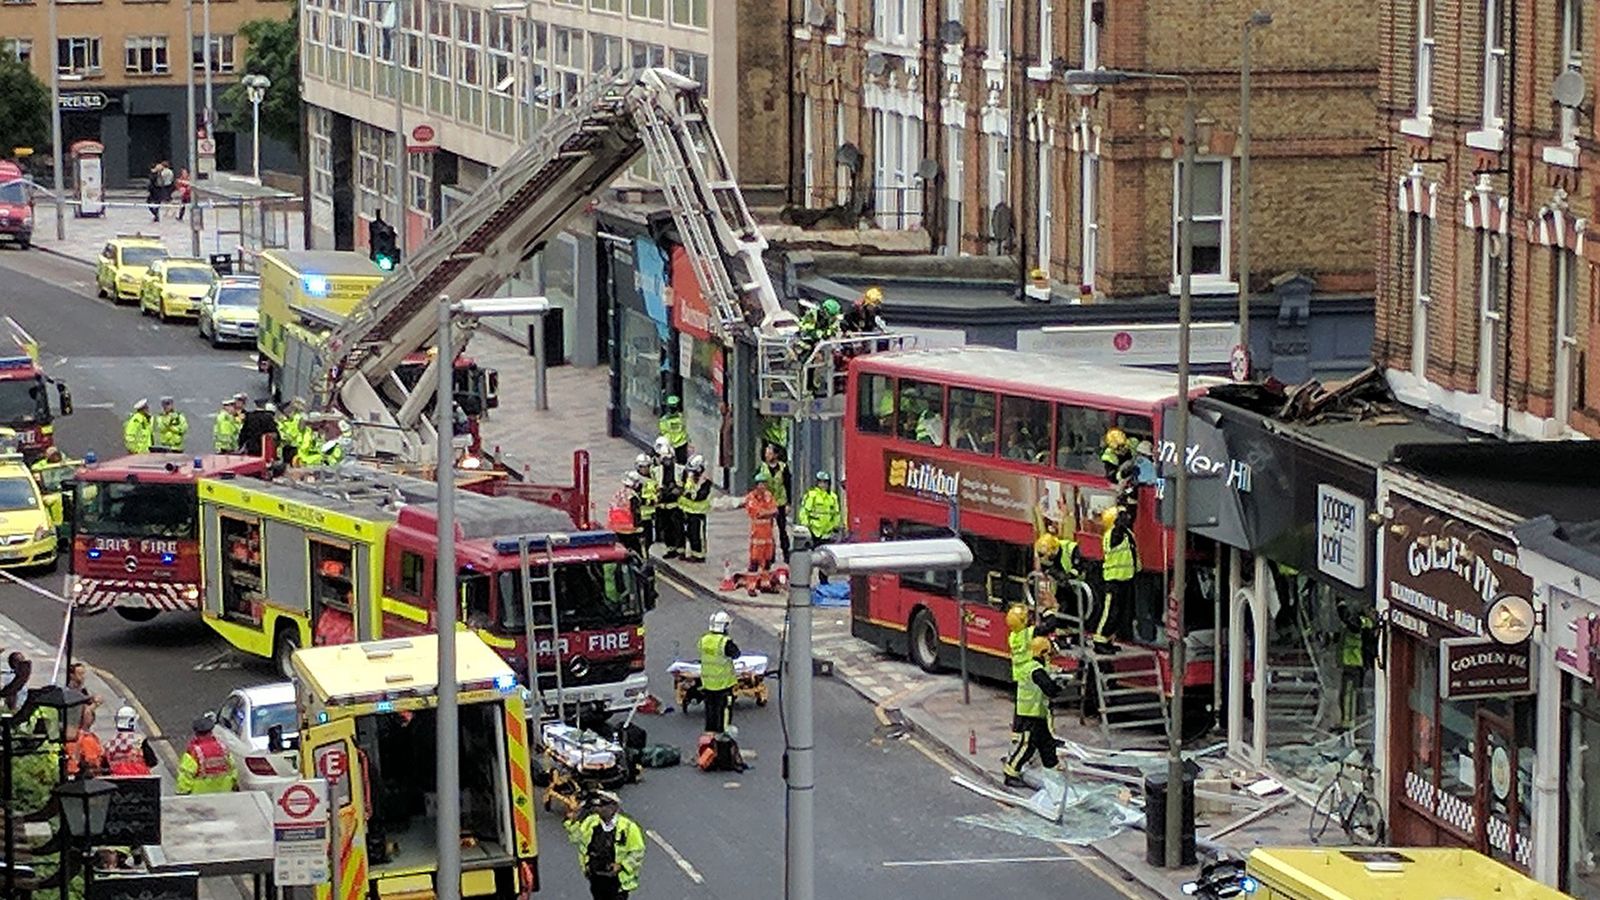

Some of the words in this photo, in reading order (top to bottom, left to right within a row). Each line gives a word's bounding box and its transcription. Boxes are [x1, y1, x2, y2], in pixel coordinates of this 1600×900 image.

[141, 541, 178, 554] FIRE
[588, 632, 630, 652] FIRE
[1451, 653, 1505, 672] GOLDEN
[326, 751, 342, 776] E
